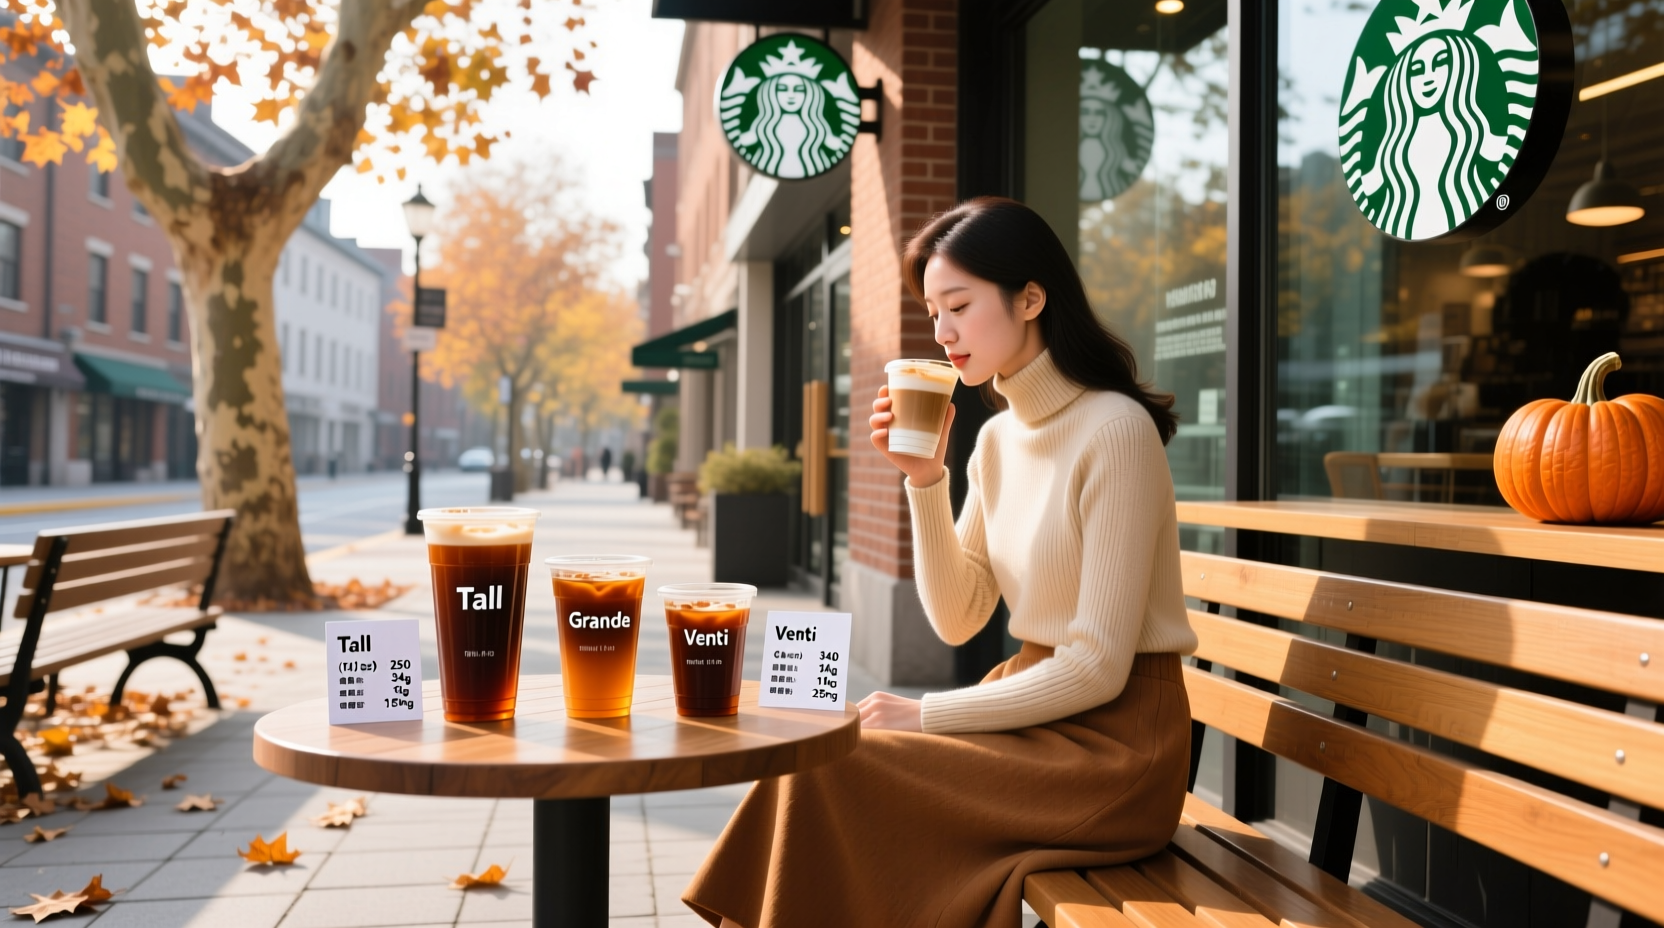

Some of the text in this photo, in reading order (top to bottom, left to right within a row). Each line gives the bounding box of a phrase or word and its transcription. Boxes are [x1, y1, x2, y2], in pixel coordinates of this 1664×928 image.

[456, 585, 503, 610] Tall
[568, 610, 631, 629] Grande
[684, 629, 729, 647] Venti
[775, 625, 817, 642] Venti
[337, 634, 371, 653] Tall
[390, 659, 411, 670] 250
[819, 650, 839, 661] 340
